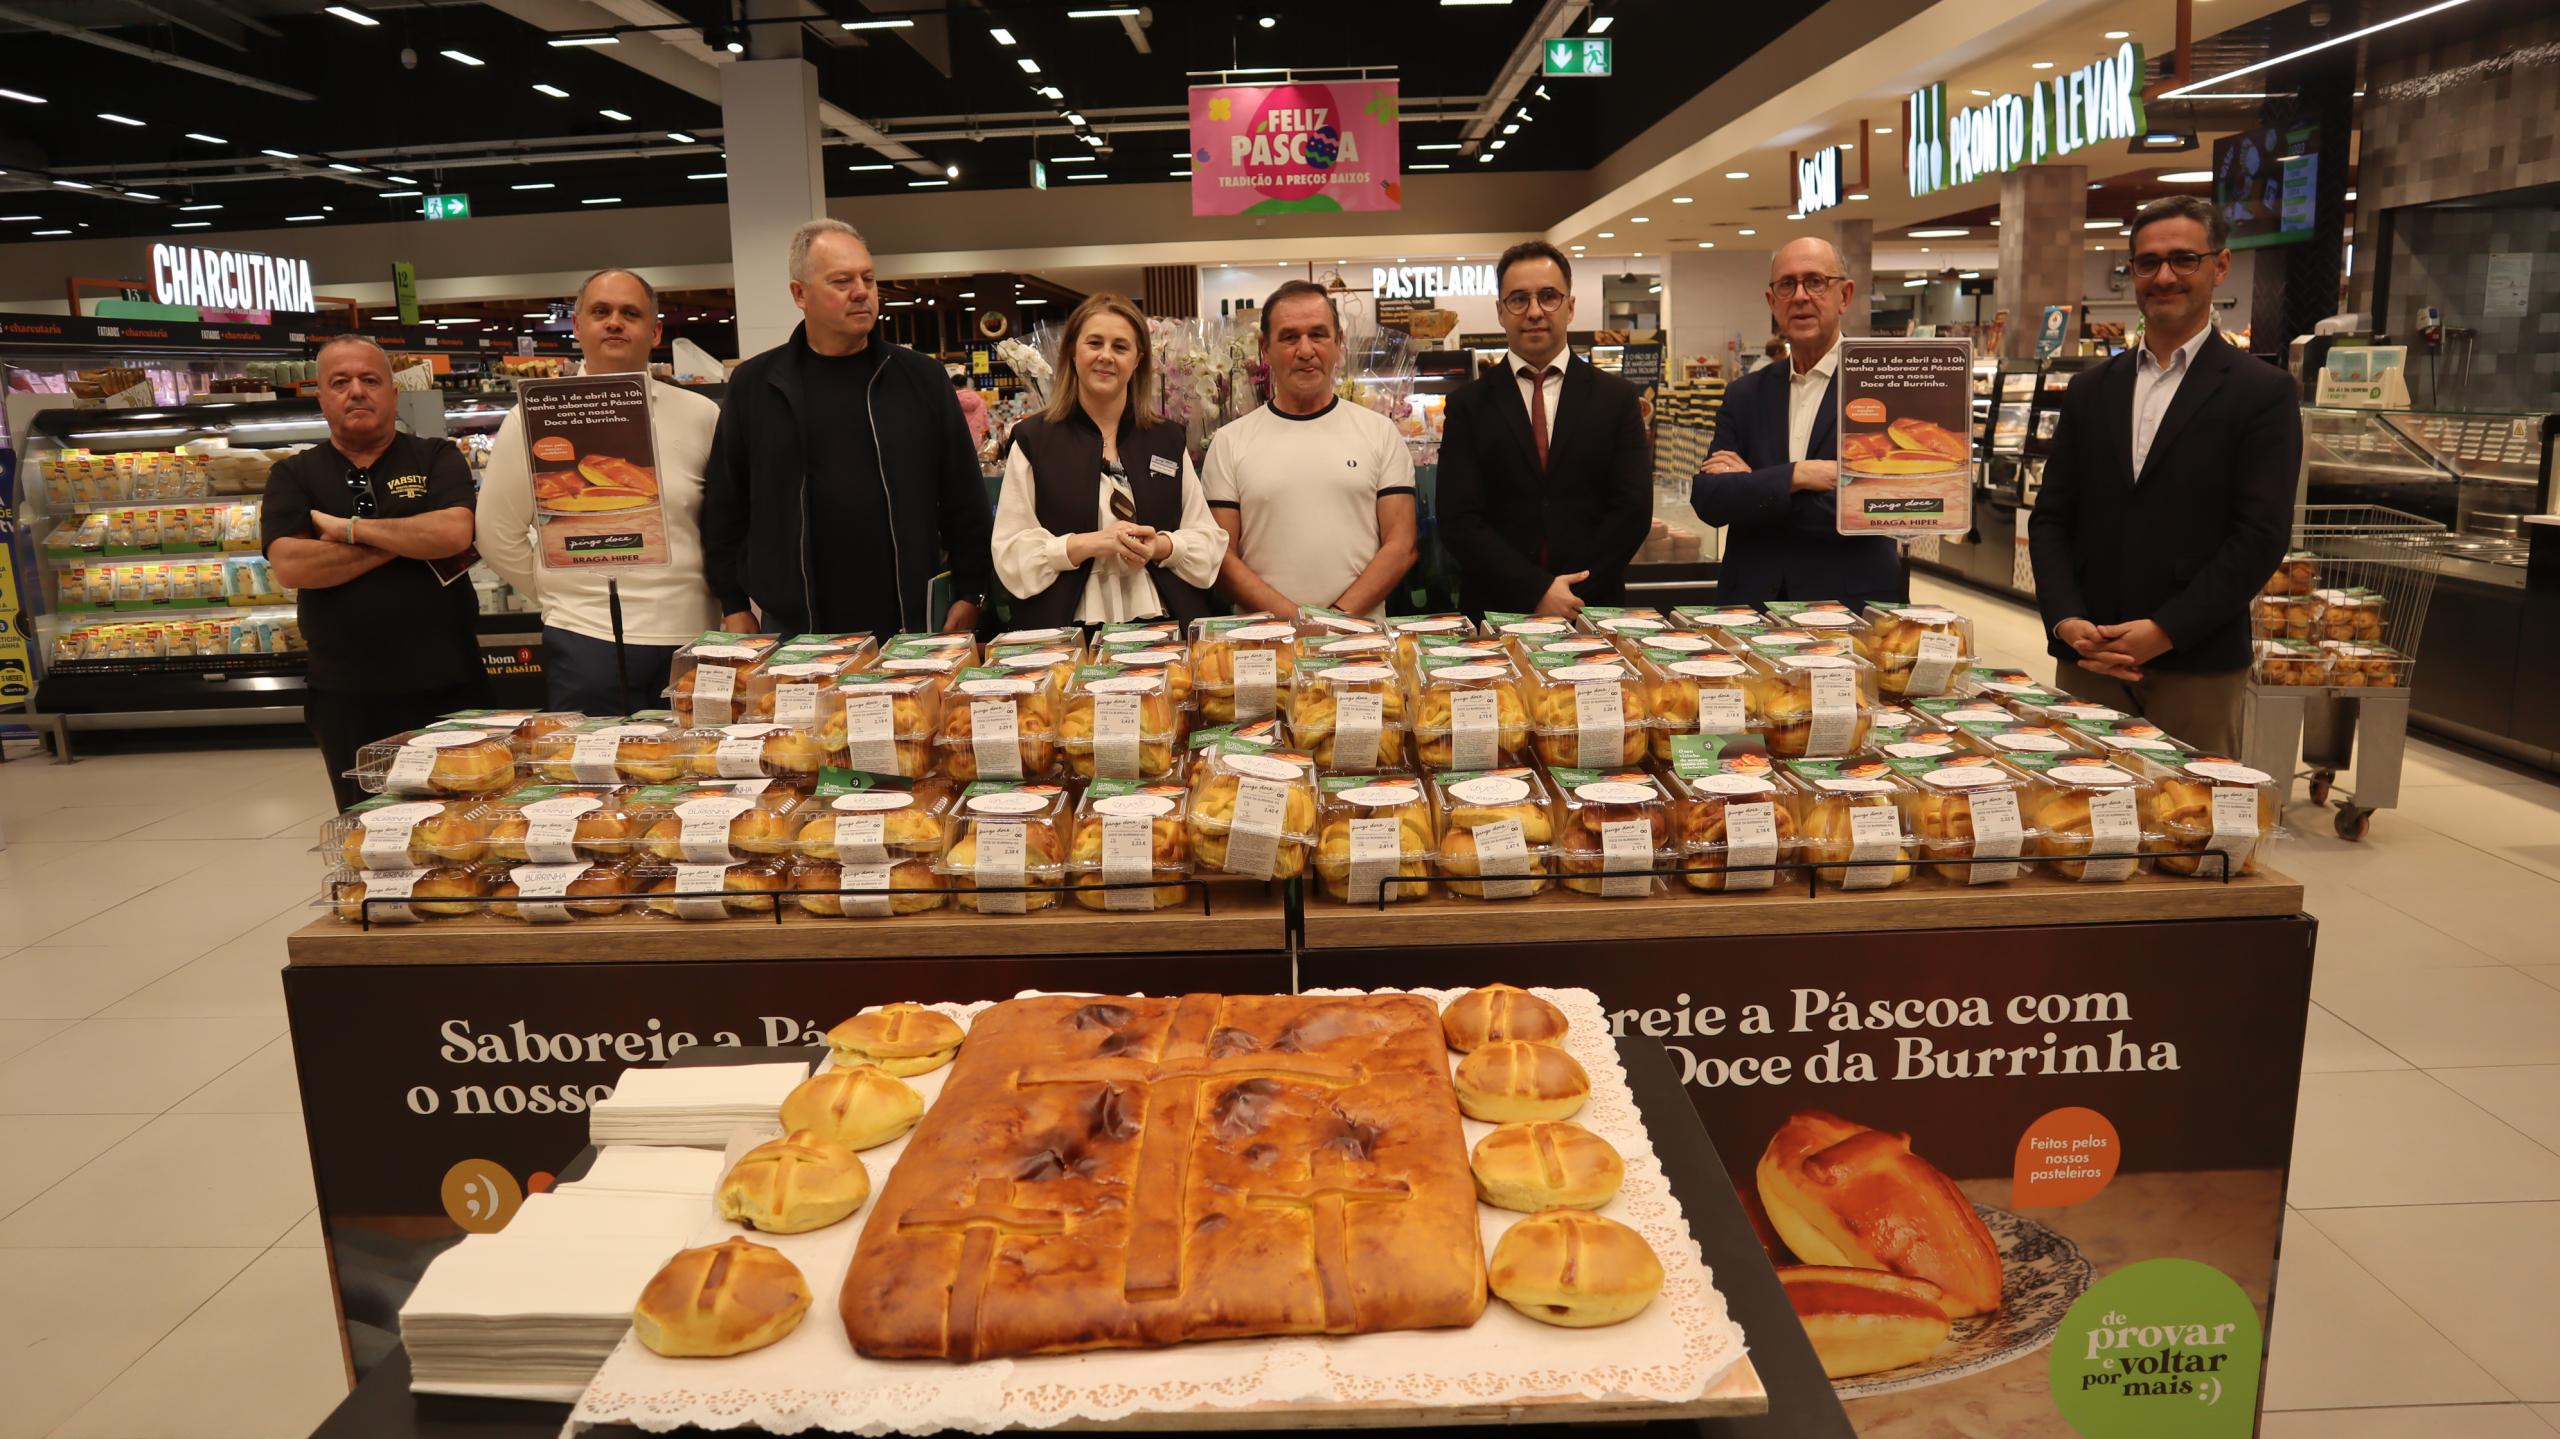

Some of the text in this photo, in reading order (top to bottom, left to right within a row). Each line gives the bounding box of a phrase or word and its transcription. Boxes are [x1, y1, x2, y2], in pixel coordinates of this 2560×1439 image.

[1268, 108, 1328, 132] FELIZ
[1950, 42, 2136, 186] PRONTO A LEVAR
[1218, 172, 1370, 188] TRADIÇÃO A PREÇOS BAIXOS
[153, 243, 316, 313] CHARCUTARIA
[398, 271, 409, 288] 12
[1373, 264, 1499, 299] PASTELARIA
[543, 394, 558, 402] dia
[585, 391, 607, 399] abril
[527, 403, 556, 411] venha
[558, 401, 599, 409] saborear
[544, 415, 630, 426] Doce da Burrinha.
[1868, 502, 1901, 512] pingo
[570, 538, 602, 549] pingo
[573, 556, 609, 564] BRAGA
[488, 655, 516, 664] bom
[506, 663, 542, 673] assim
[525, 872, 567, 882] BURRINHA
[1609, 987, 2132, 1038] reie a Páscoa com
[440, 1018, 698, 1063] Saboreie
[758, 1016, 828, 1047] Pá
[1804, 1040, 1878, 1084] da
[1892, 1030, 2181, 1080] Burrinha
[407, 1085, 616, 1114] o nosso
[2030, 1134, 2107, 1150] Feitos pelos
[2045, 1153, 2089, 1165] nossos
[2030, 1166, 2101, 1183] pasteleiros
[2102, 1311, 2127, 1326] de
[2083, 1321, 2236, 1361] provar
[2102, 1348, 2227, 1375] e voltar
[2081, 1371, 2122, 1391] por
[2123, 1375, 2193, 1397] mais
